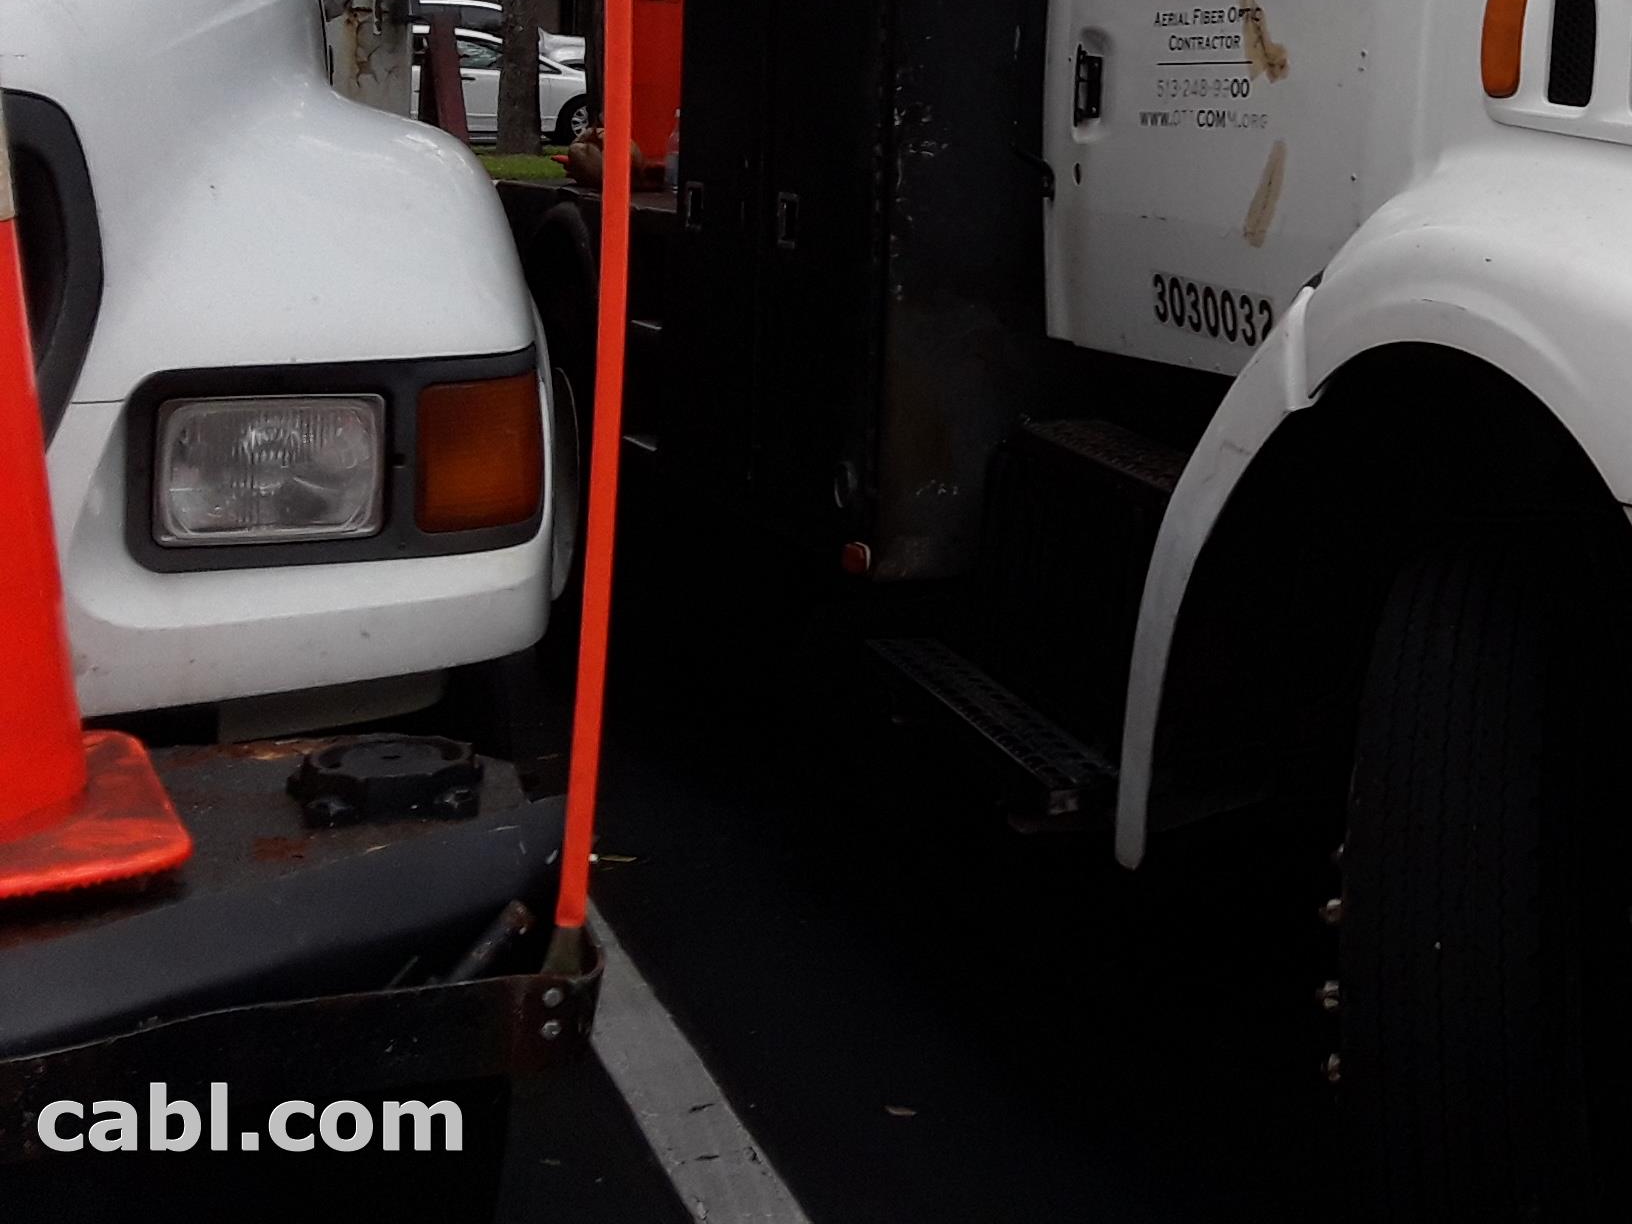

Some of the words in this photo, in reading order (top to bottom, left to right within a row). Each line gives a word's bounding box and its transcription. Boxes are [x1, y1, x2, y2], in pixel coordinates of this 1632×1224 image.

[1193, 8, 1225, 25] FIBER
[1168, 34, 1241, 51] CONTRACTOR
[1153, 273, 1273, 347] 3030032
